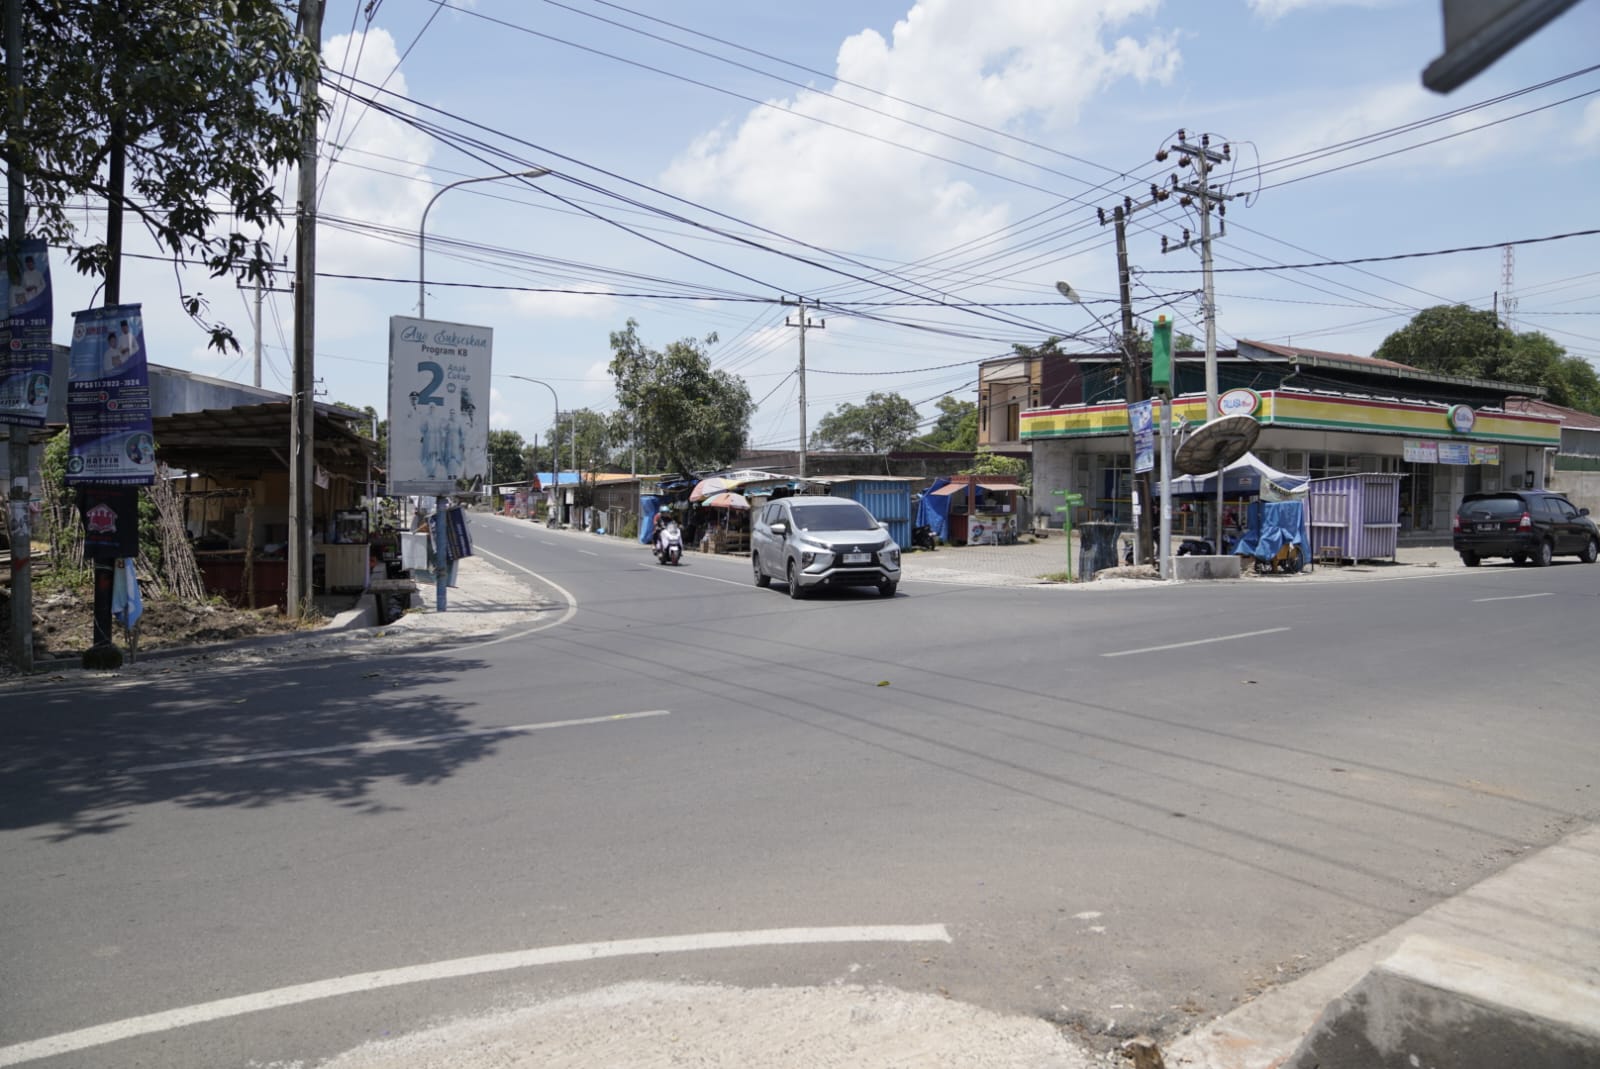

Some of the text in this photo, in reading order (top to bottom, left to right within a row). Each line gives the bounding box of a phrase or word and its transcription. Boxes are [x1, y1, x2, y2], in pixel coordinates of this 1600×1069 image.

[421, 344, 468, 357] Program KB
[417, 361, 445, 406] 2
